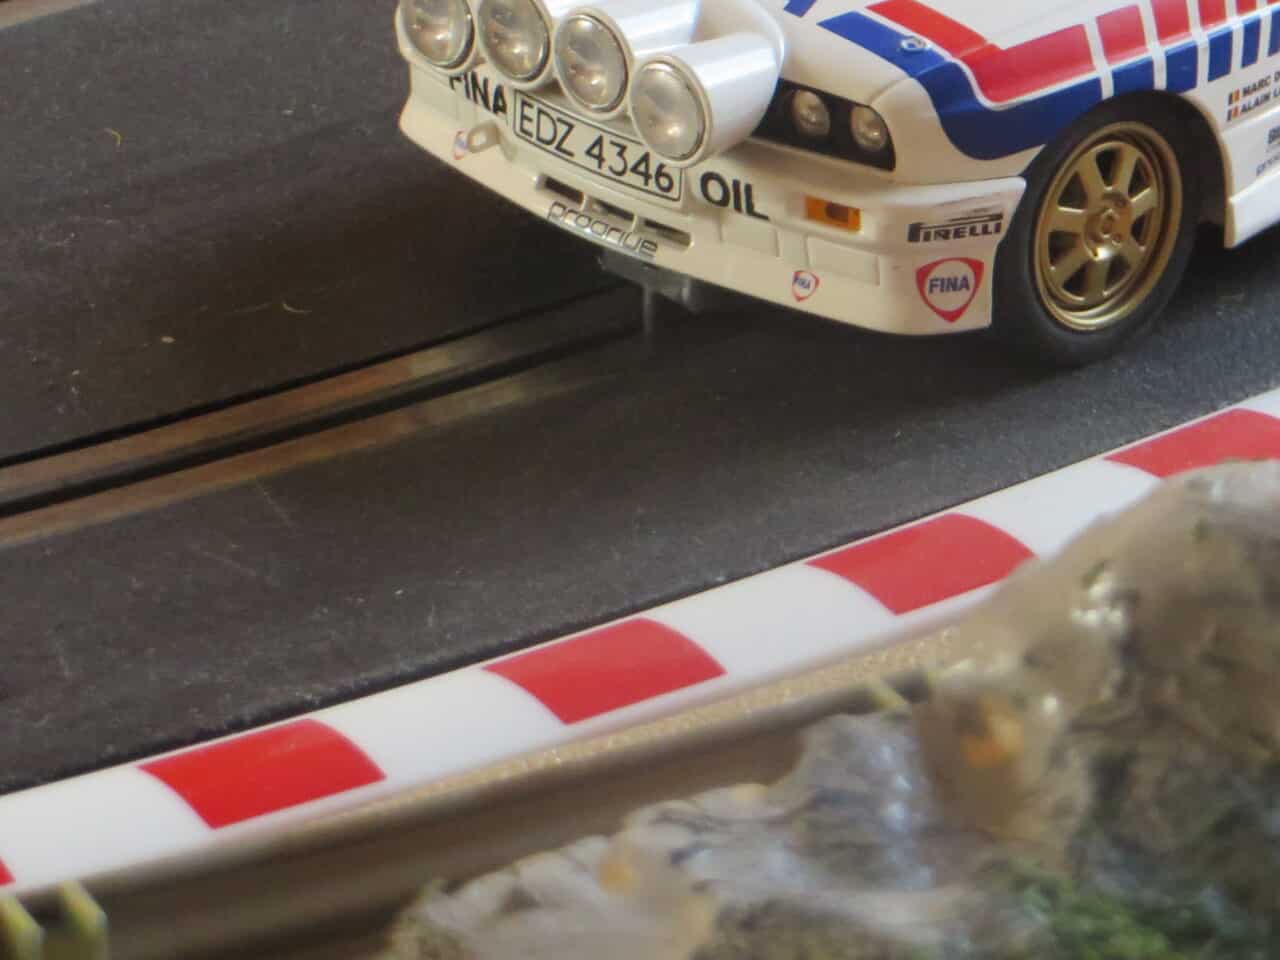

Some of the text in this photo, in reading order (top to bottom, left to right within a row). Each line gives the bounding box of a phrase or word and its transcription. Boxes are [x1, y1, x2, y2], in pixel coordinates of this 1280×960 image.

[519, 98, 675, 194] EDZ 4346
[699, 171, 769, 221] OIL
[907, 212, 1004, 243] PIRELLI
[928, 274, 971, 294] FINA
